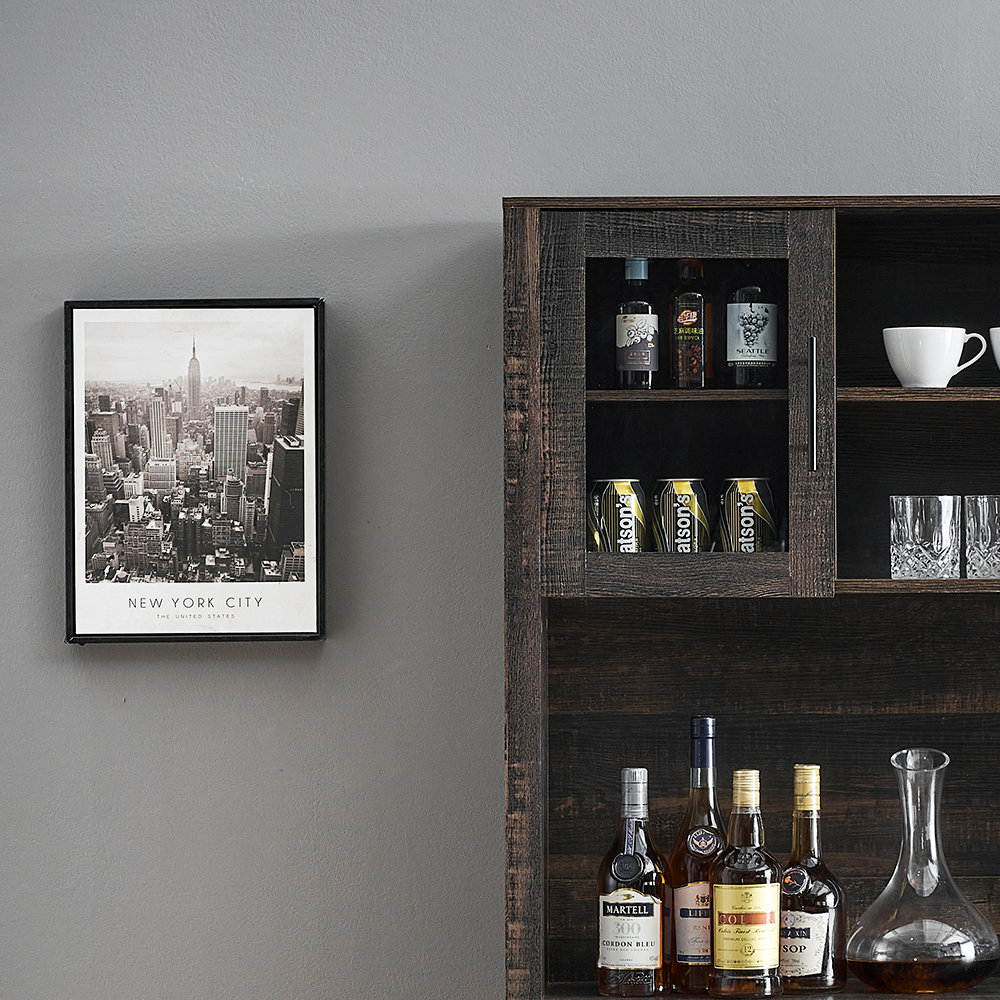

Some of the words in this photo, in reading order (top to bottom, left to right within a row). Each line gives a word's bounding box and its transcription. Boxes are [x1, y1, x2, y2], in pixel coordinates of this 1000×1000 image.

[128, 597, 163, 608] NEW
[171, 597, 215, 608] YORK
[225, 597, 263, 608] CITY
[606, 905, 649, 915] MARTELL
[613, 921, 641, 935] 300
[602, 940, 633, 948] CORDON
[635, 940, 656, 948] BLEU
[744, 945, 752, 953] 12
